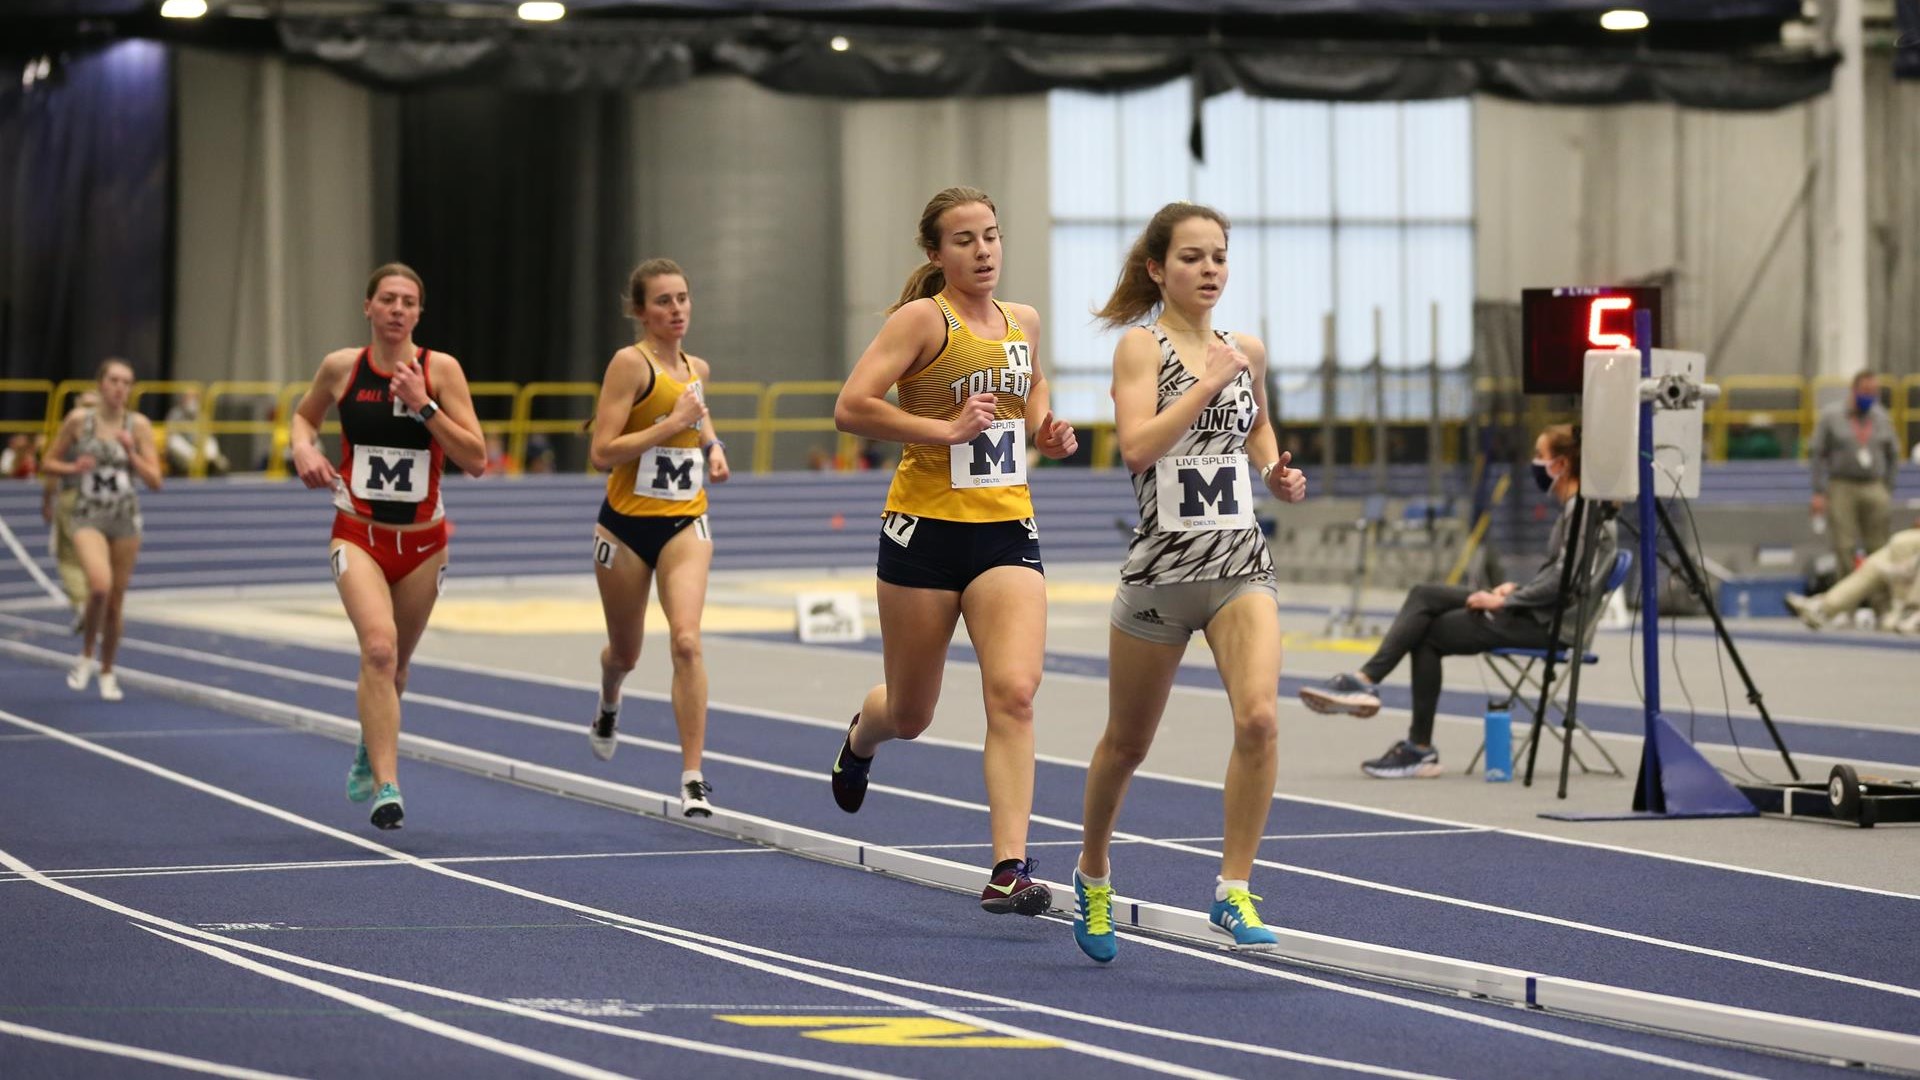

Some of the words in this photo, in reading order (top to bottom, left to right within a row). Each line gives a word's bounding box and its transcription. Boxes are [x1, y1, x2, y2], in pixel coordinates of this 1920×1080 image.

[1009, 345, 1029, 366] 17
[1237, 390, 1253, 433] 3
[991, 421, 1016, 430] SPLITS
[969, 430, 1016, 475] M
[1175, 458, 1199, 466] LIVE
[1201, 456, 1237, 465] SPLITS
[93, 472, 119, 492] M
[366, 455, 414, 492] M
[652, 455, 694, 490] M
[1178, 466, 1239, 518] M
[889, 512, 916, 537] 17
[1192, 519, 1216, 527] DELTA
[594, 535, 610, 564] 10
